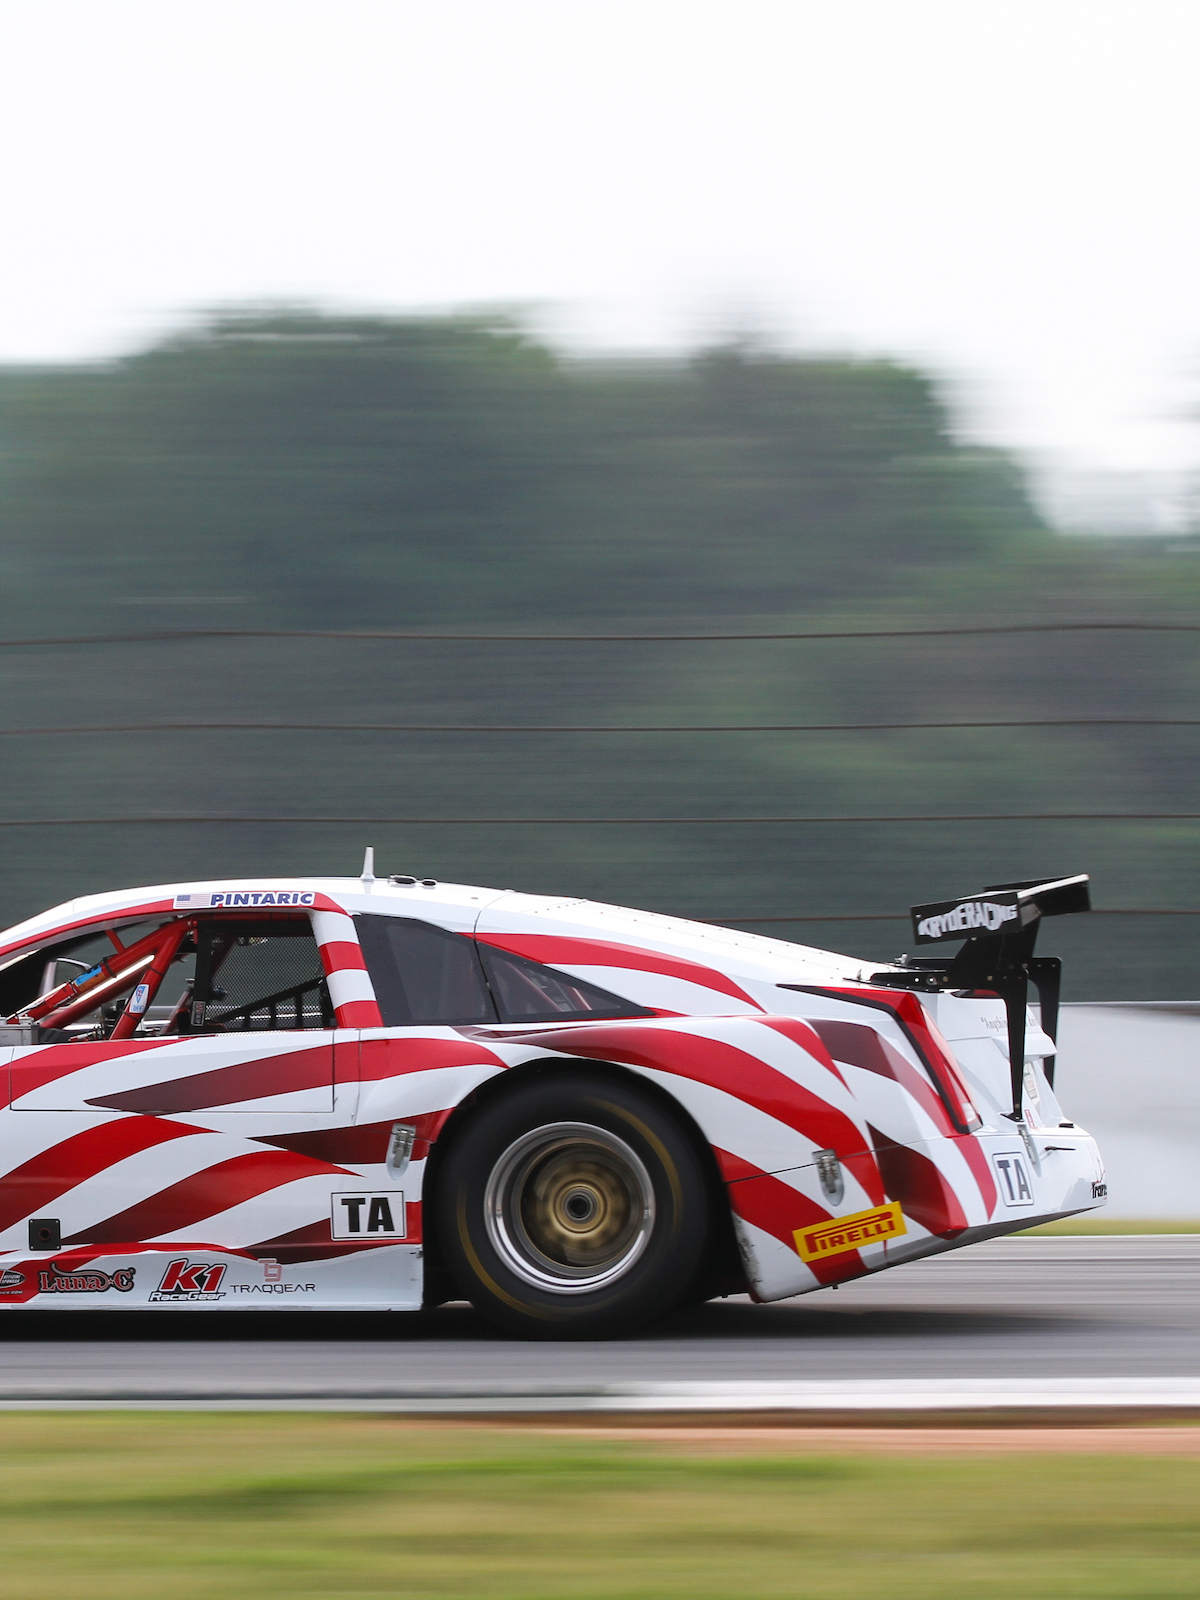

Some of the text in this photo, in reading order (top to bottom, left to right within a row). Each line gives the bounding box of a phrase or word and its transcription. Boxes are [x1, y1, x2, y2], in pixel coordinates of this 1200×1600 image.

[210, 893, 313, 906] PINTARIC
[997, 1159, 1031, 1201] TA
[341, 1197, 395, 1232] TA
[804, 1212, 896, 1254] PIRELLI
[158, 1259, 227, 1293] K1
[150, 1292, 226, 1301] RaceGear
